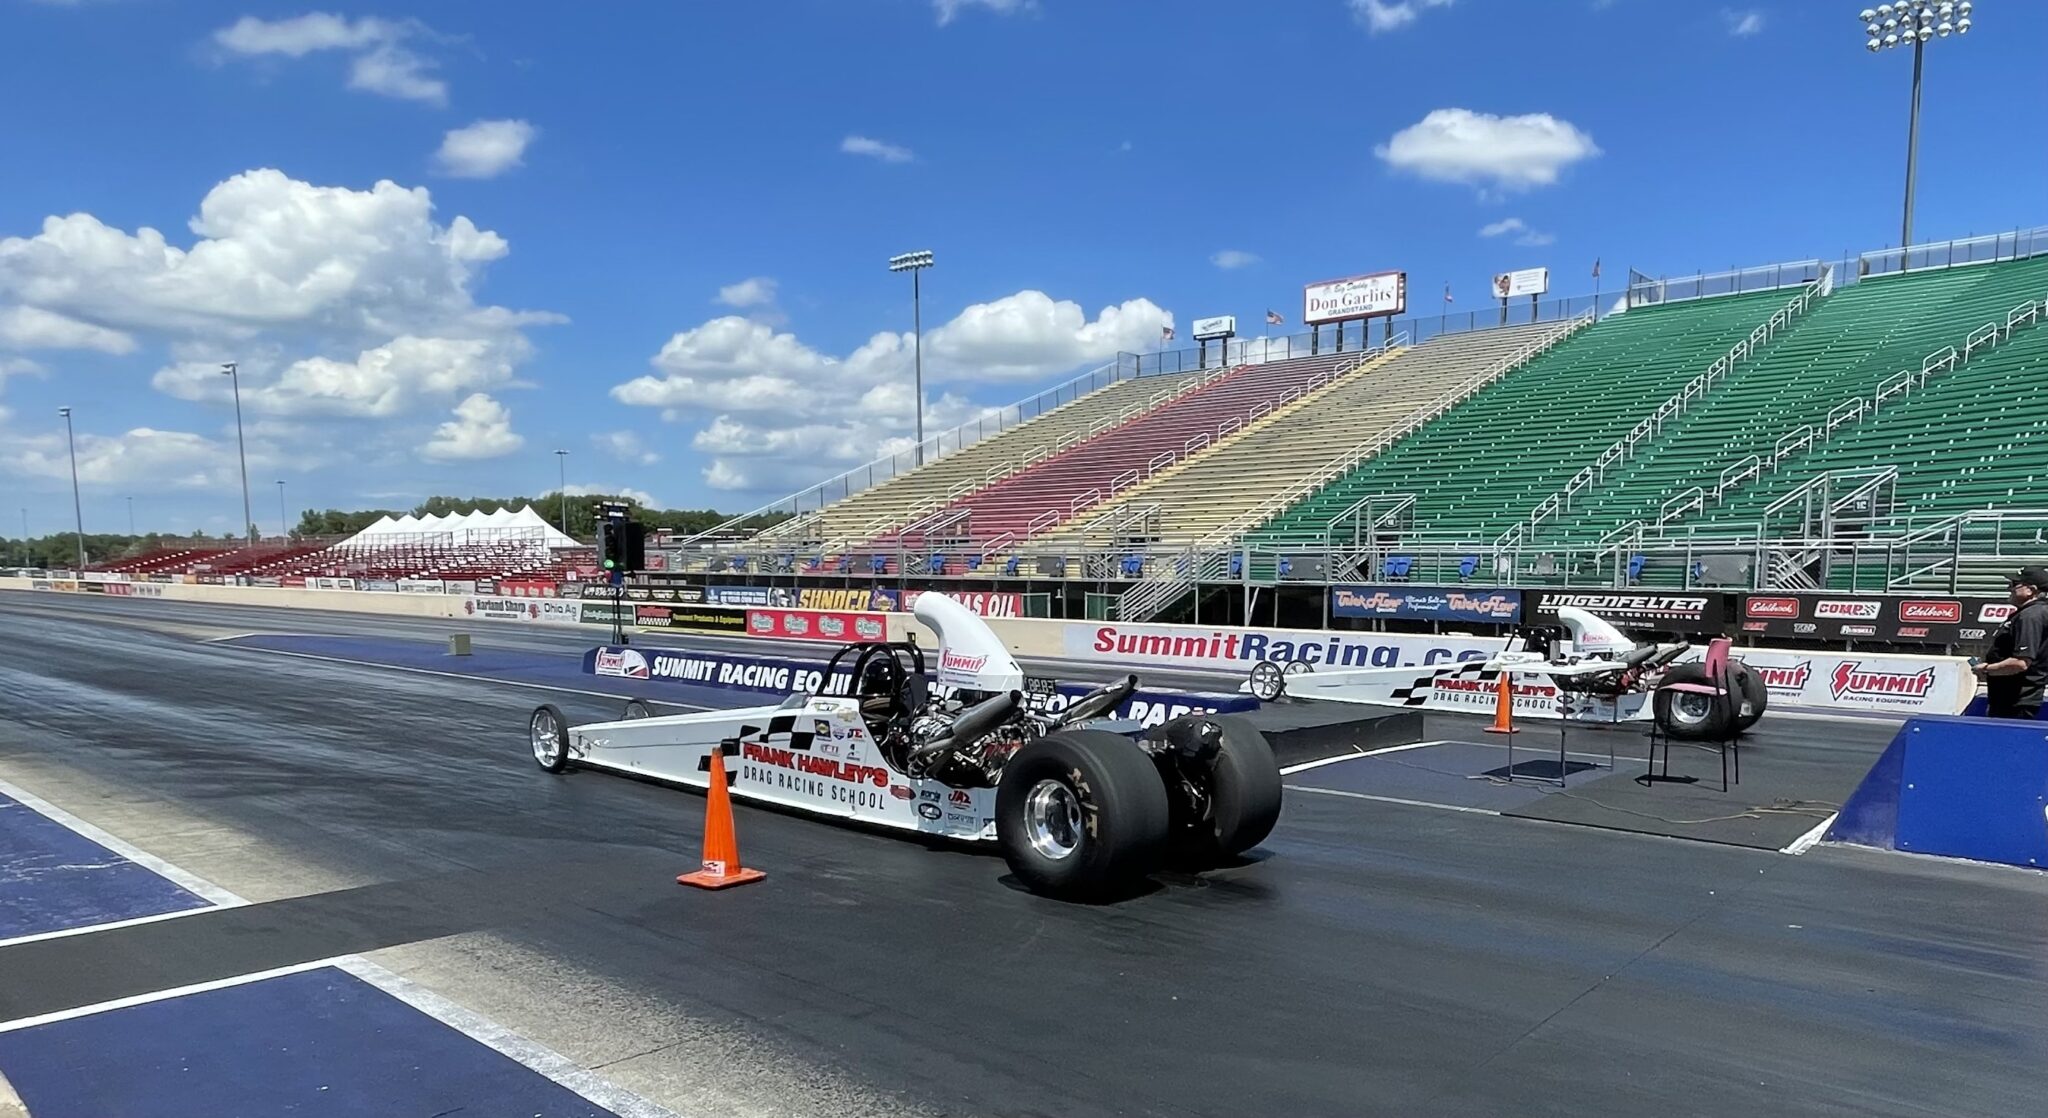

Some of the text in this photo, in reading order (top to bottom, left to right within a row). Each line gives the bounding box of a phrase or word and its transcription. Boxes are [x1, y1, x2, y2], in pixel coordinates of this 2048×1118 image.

[1310, 286, 1395, 312] Don Garlits'
[1328, 304, 1374, 316] GRANDSTAND
[505, 600, 526, 613] Sharp
[798, 589, 871, 610] SUNOCO
[988, 594, 1015, 617] OIL
[1539, 594, 1708, 611] LINGENFELTER
[1751, 601, 1793, 614] Edelbrock
[544, 603, 563, 613] Ohio
[565, 604, 577, 617] Ag
[1619, 612, 1701, 620] ENGINEERING
[1905, 606, 1954, 618] Edelbrock
[942, 650, 987, 672] SUMMIT
[651, 656, 715, 681] SUMMIT
[717, 666, 788, 690] RACING
[1832, 662, 1932, 699] SUMMIT
[1434, 679, 1556, 697] FRANK HALEY'S
[1433, 692, 1459, 702] DRAG
[1464, 695, 1497, 705] RACIN
[1843, 695, 1924, 706] RACING EQUIPMENT
[743, 742, 889, 788] FRANK HAWLEY'S
[743, 765, 772, 785] DRAG
[778, 773, 824, 797] RACING
[831, 785, 885, 810] SCHOOL
